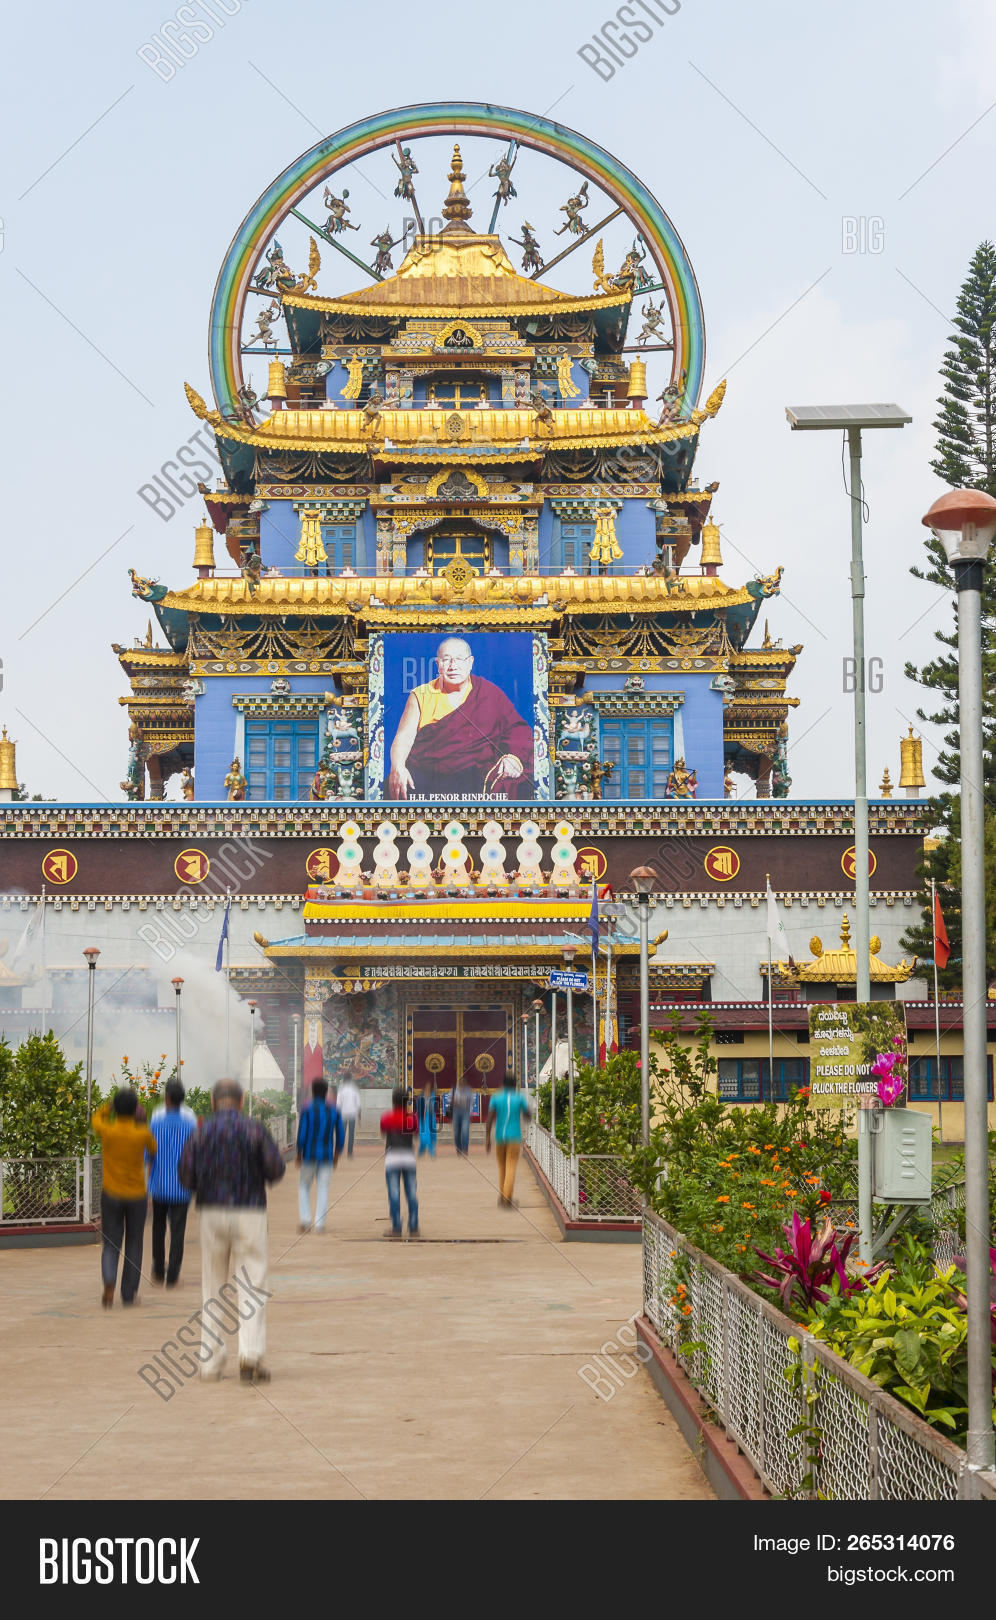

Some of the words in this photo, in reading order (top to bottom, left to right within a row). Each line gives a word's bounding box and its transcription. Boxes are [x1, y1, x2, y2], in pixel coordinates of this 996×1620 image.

[409, 793, 427, 801] H.H.
[429, 793, 460, 801] PENOR
[461, 792, 509, 801] RINPOCHE
[816, 1065, 844, 1076] PLEASE
[844, 1065, 855, 1075] DO
[856, 1064, 870, 1075] NOT
[812, 1082, 834, 1094] PLUCK
[834, 1082, 848, 1094] THE
[848, 1082, 878, 1093] FLOWERS
